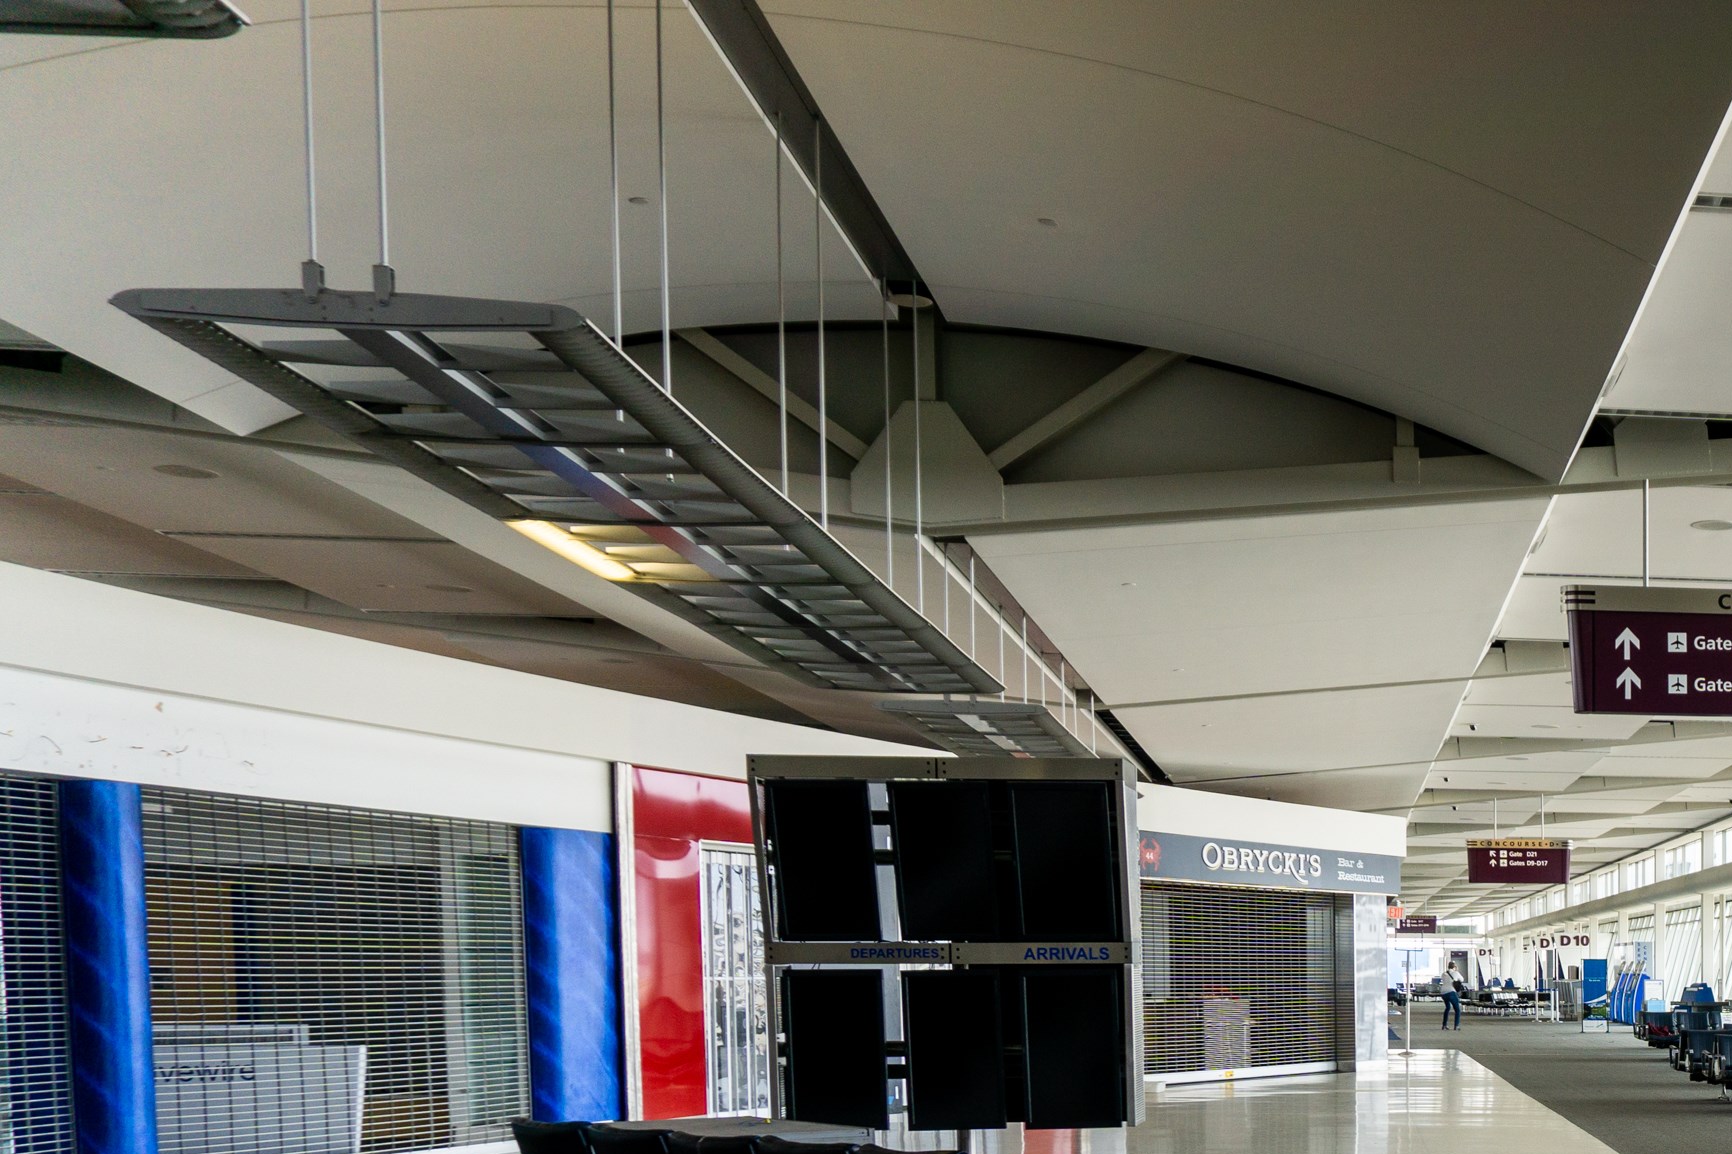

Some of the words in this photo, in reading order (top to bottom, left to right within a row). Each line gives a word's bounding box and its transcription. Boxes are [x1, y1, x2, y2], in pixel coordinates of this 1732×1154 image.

[1509, 850, 1523, 858] Gate
[1526, 850, 1538, 858] D21
[1201, 842, 1322, 885] OBRYCKI'S
[1337, 857, 1355, 868] Bar
[1356, 859, 1364, 868] &
[1337, 871, 1385, 884] Restaurant
[850, 948, 939, 960] DEPARTURES
[1023, 947, 1110, 961] ARRIVALS
